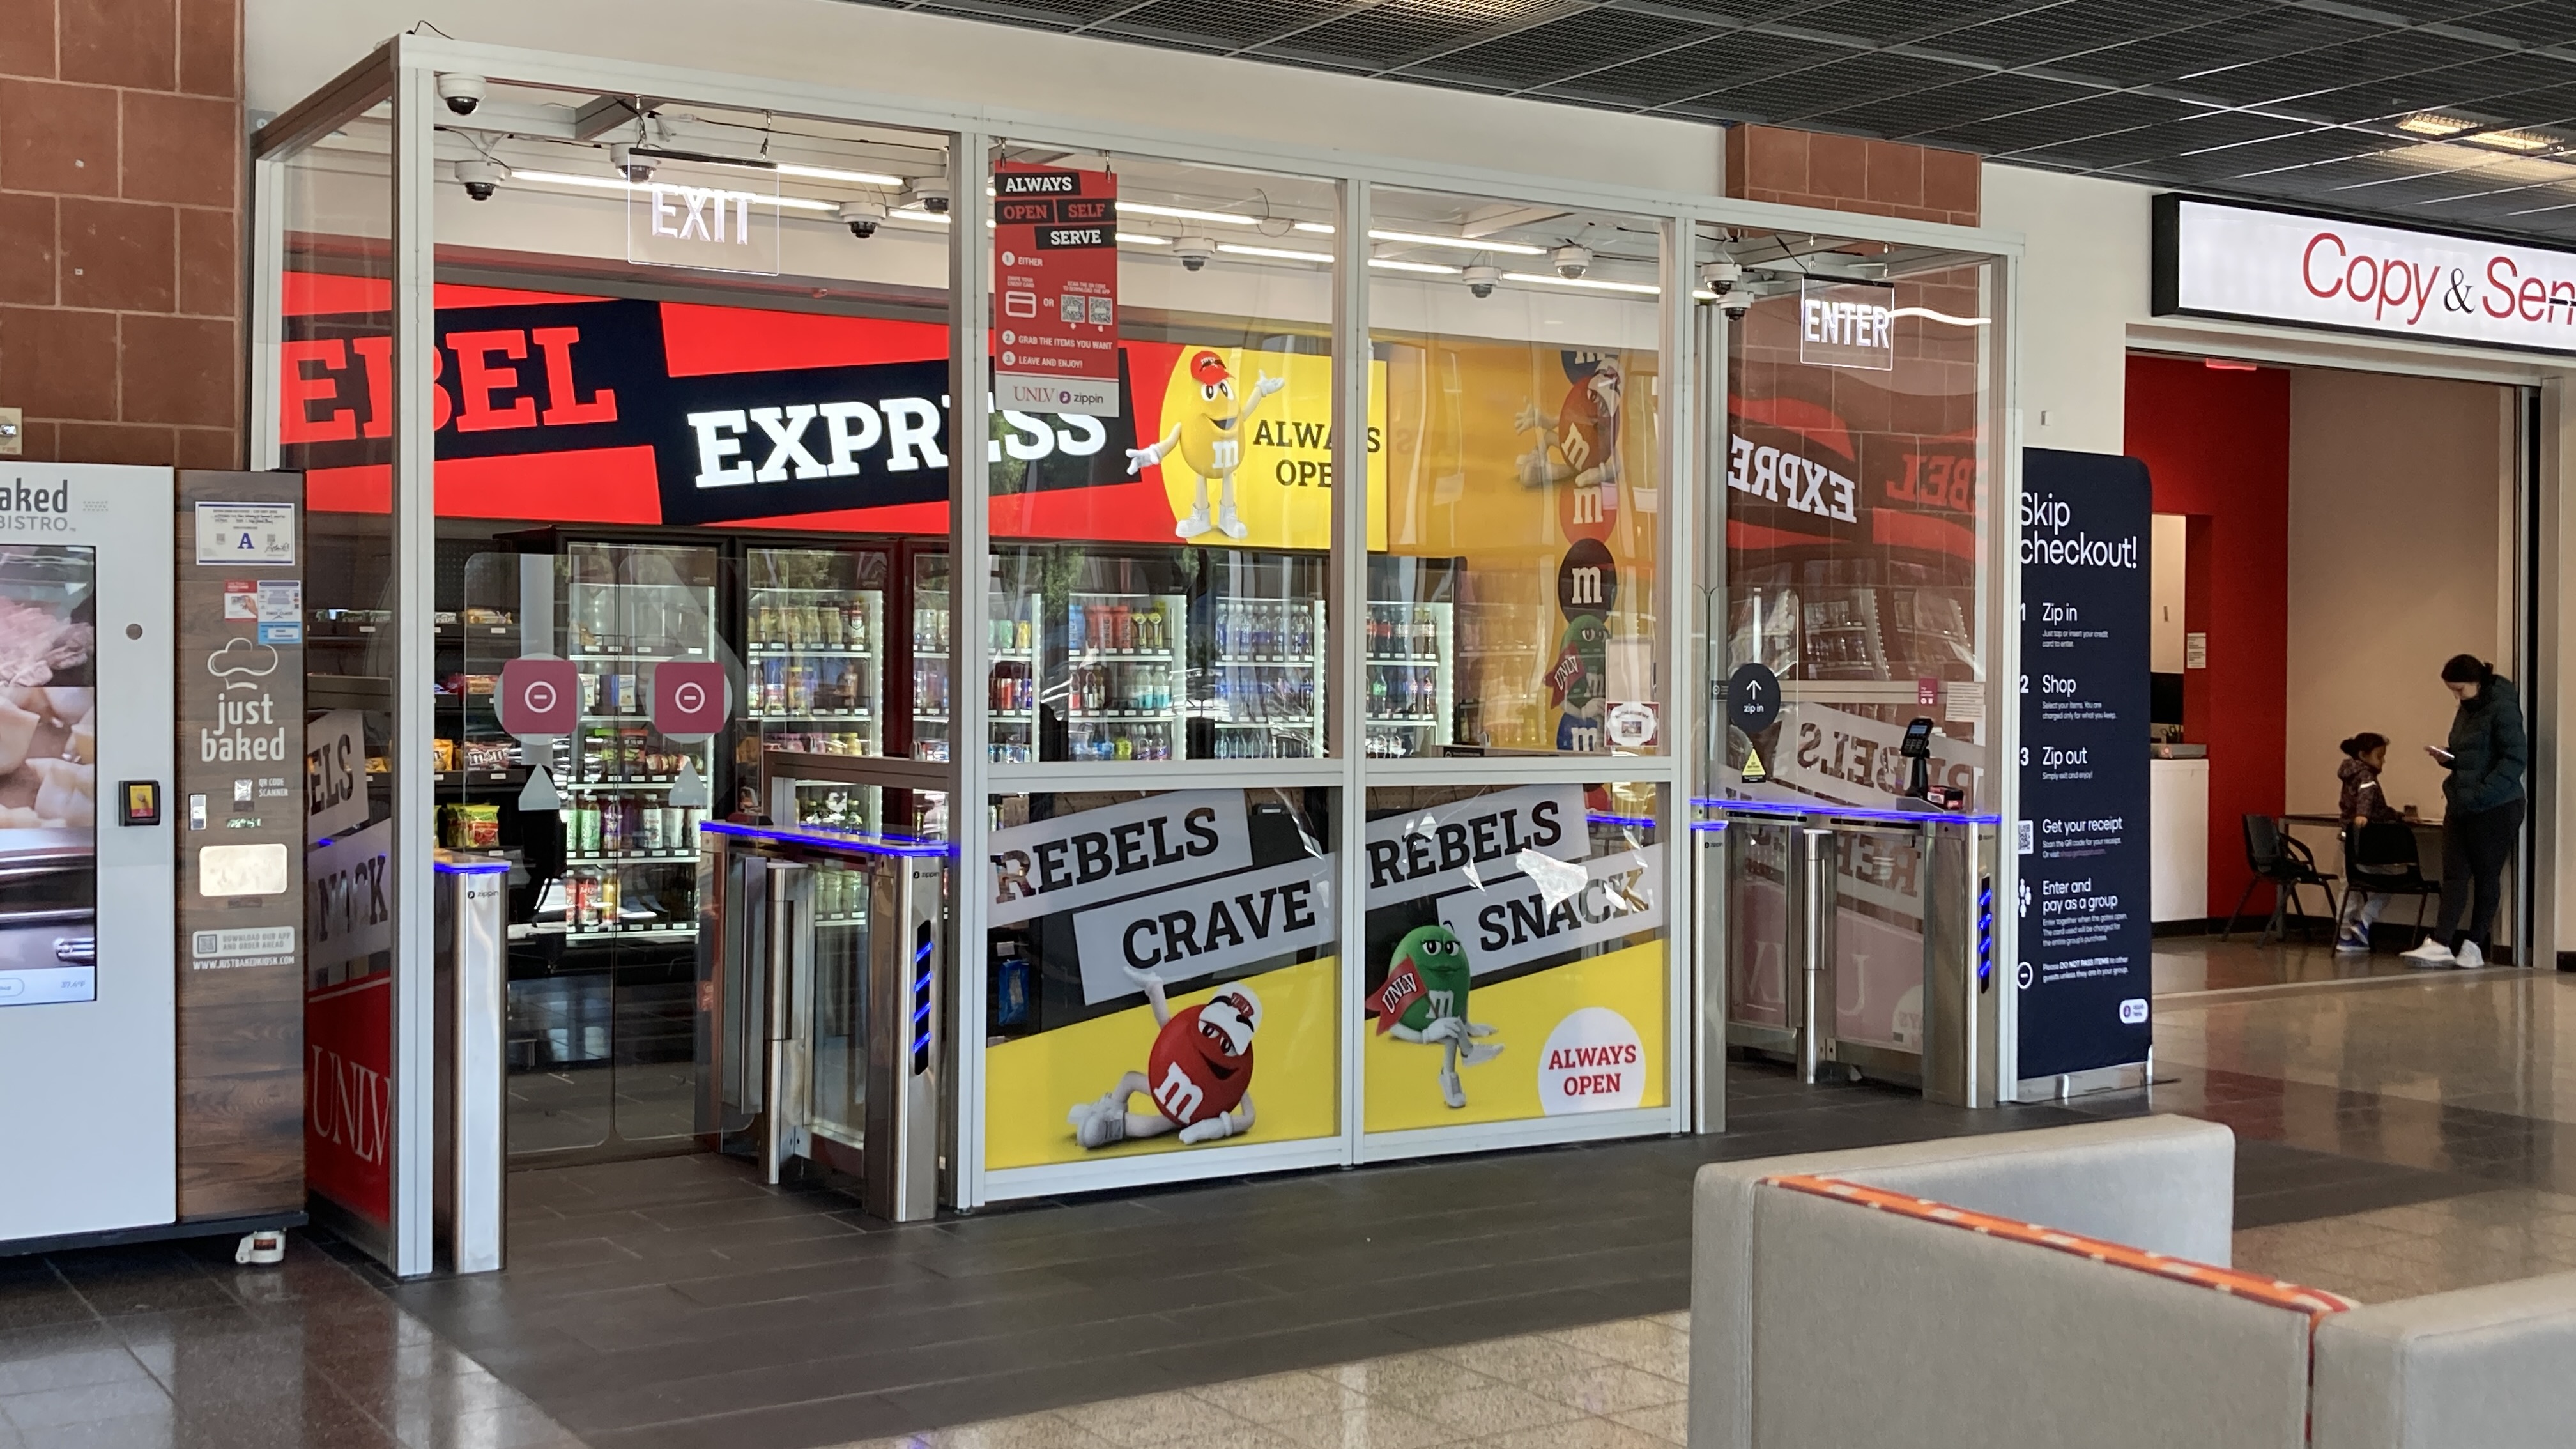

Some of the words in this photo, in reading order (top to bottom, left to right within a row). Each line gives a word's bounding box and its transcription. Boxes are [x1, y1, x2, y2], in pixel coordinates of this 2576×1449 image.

[1005, 176, 1073, 192] ALWAYS
[652, 183, 756, 246] EXIT
[1003, 204, 1048, 220] OPEN
[1068, 203, 1105, 218] SELF
[1050, 229, 1101, 245] SERVE
[1018, 256, 1043, 266] EITHER
[2303, 233, 2441, 325] Copy
[2444, 268, 2475, 314] &
[1043, 298, 1054, 307] OR
[1805, 298, 1889, 349] ENTER
[1018, 335, 1038, 345] GRAB
[1040, 337, 1052, 346] THE
[1054, 337, 1075, 348] ITEMS
[1077, 340, 1091, 349] YOU
[1092, 341, 1113, 350] WANT
[1018, 356, 1040, 365] LEAVE
[1041, 358, 1056, 367] AND
[1058, 359, 1083, 368] ENJOY!
[1013, 385, 1055, 402] UNLV
[1074, 392, 1104, 405] zippin
[1253, 419, 1381, 453] ALWS
[1275, 459, 1331, 488] OPE
[2021, 491, 2071, 535] Skip
[237, 532, 255, 549] A
[2021, 530, 2137, 569] checkout!
[2042, 602, 2064, 626] Zip
[2066, 602, 2078, 622] in
[1554, 656, 1579, 691] UNLV
[2020, 675, 2029, 694] 2
[2042, 675, 2076, 698] Shop
[213, 693, 273, 735] just
[1744, 703, 1756, 714] zip
[1756, 703, 1764, 712] in
[201, 727, 285, 762] baked
[2020, 747, 2029, 766] 3
[2042, 746, 2063, 770] Zip
[2066, 747, 2088, 765] out
[259, 778, 268, 788] QR
[268, 778, 284, 786] CODE
[259, 788, 288, 797] SCANNER
[2042, 818, 2063, 834] Get
[2064, 820, 2086, 836] your
[2088, 815, 2123, 833] receipt
[990, 806, 1220, 905] REBELS
[1366, 800, 1562, 889] REBELS
[477, 889, 499, 898] zippin
[2043, 880, 2069, 895] Enter
[2071, 877, 2092, 893] and
[2043, 900, 2063, 916] pay
[2064, 898, 2077, 910] as
[2079, 898, 2086, 908] a
[2088, 895, 2118, 912] group
[1123, 879, 1316, 969] CRAVE
[222, 933, 260, 943] DOWNLOAD
[223, 942, 236, 951] AND
[238, 941, 259, 950] ORDER
[262, 940, 284, 949] AHEAD
[1381, 971, 1416, 1015] UNLV
[1549, 1044, 1637, 1070] ALWAYS
[1563, 1073, 1621, 1096] OPEN
[312, 1044, 391, 1167] UNLV
